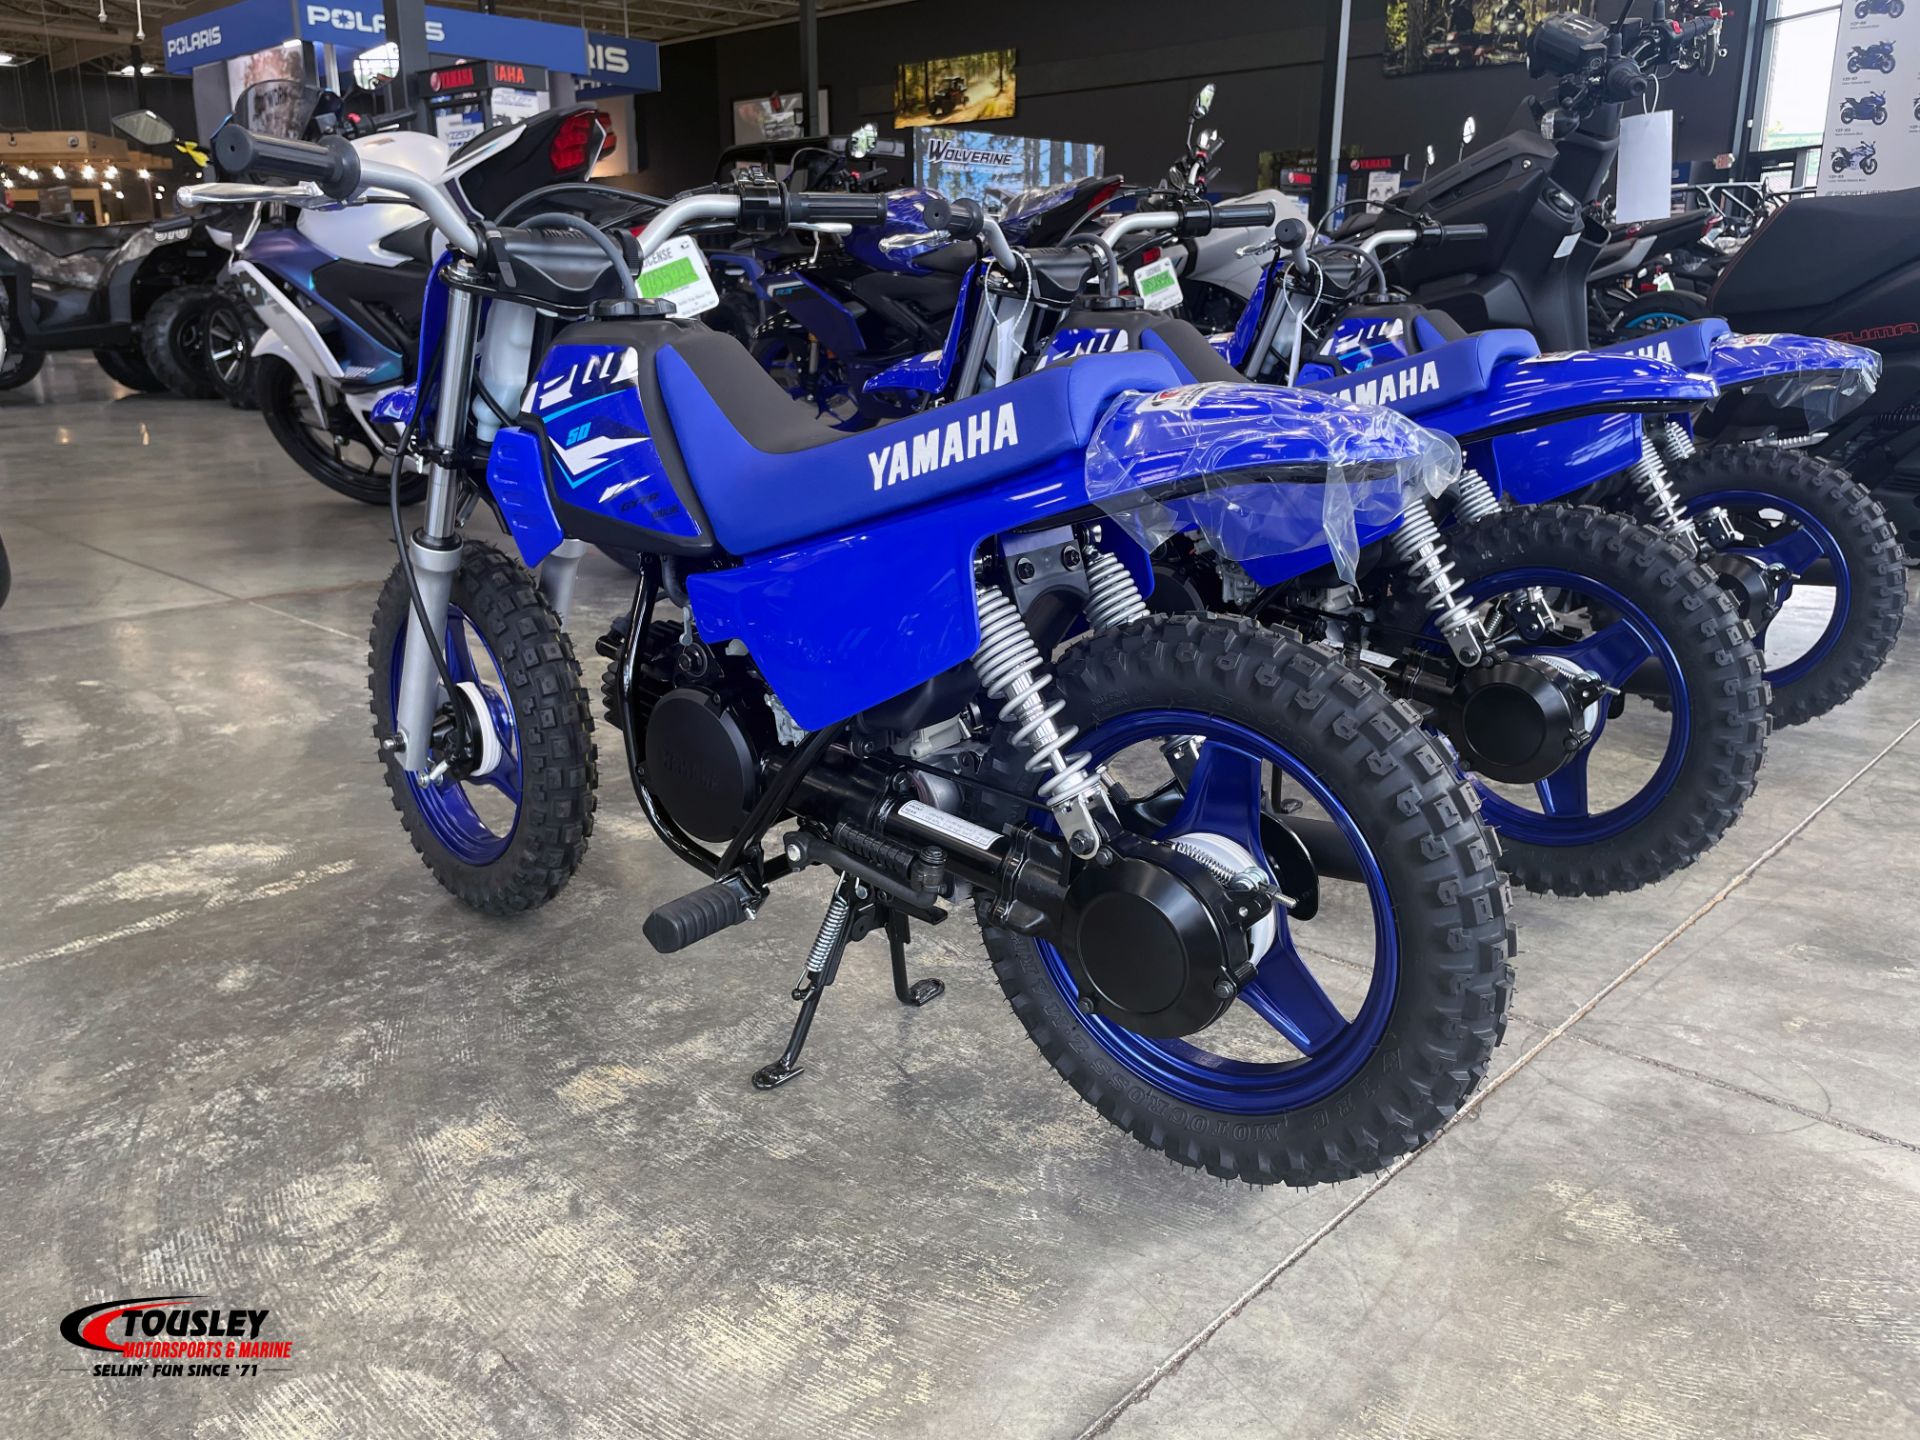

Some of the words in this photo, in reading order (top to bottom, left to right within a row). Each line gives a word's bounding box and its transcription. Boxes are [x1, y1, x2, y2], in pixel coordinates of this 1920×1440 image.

[167, 26, 222, 58] POLARIS
[928, 138, 1014, 167] WOLVERINE
[566, 422, 592, 446] 50
[868, 402, 1018, 491] YAMAHA
